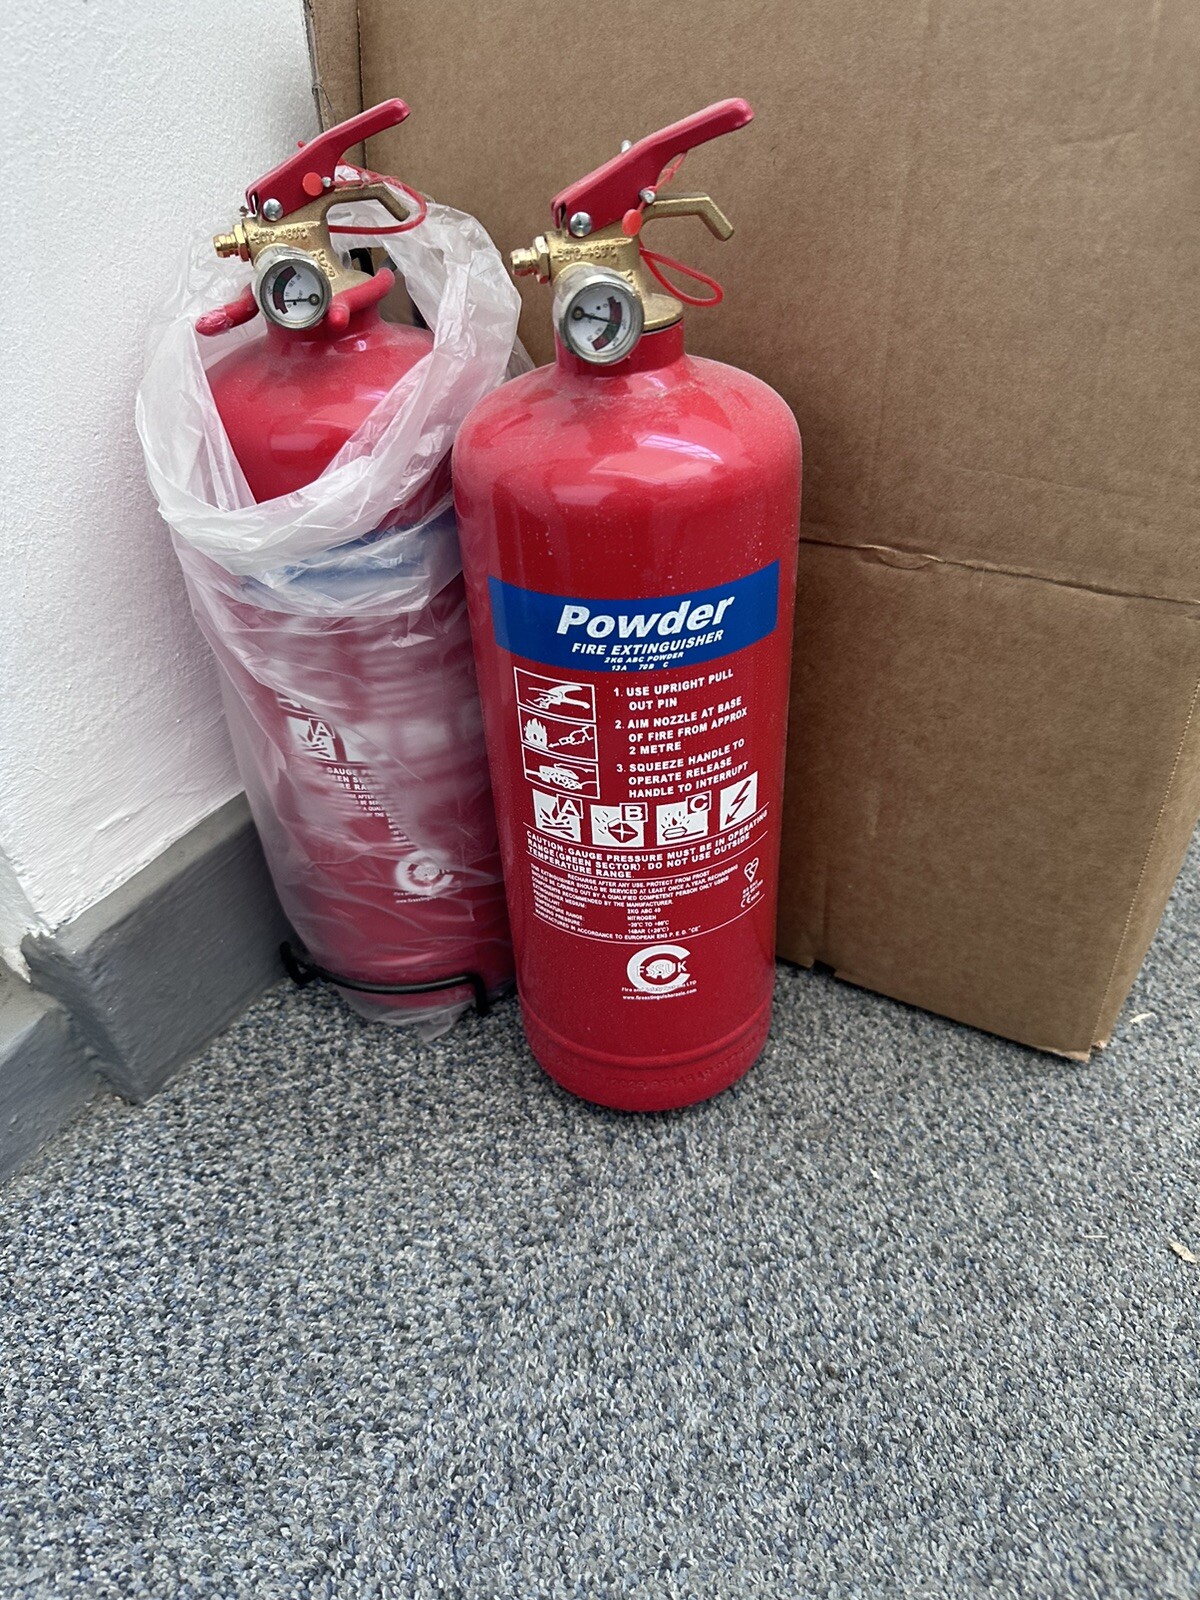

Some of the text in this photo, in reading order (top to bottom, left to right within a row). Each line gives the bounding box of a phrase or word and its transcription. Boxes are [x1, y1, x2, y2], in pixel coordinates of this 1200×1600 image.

[556, 596, 735, 638] Powder
[572, 629, 724, 656] FIRE EXTINGUISHER
[646, 651, 684, 662] POWDER
[614, 668, 734, 697] 1. USE UPRIGHT PULL
[615, 696, 742, 730] 2. AIM NOZZLE AT BASE
[628, 698, 678, 711] OUT PIN
[315, 722, 330, 736] A
[628, 706, 748, 742] OF FIRE FROM APPROX
[616, 738, 745, 773] 3. SQUEEZE HANDLE TO
[629, 742, 682, 755] 2 METRE
[628, 756, 732, 786] OPERATE RELEASE
[628, 762, 749, 798] HANDLE TO INTERRUPT
[559, 794, 708, 820] A B C
[568, 848, 603, 860] GAUGE
[606, 853, 663, 864] PRESSURE
[666, 847, 696, 860] MUST
[700, 842, 712, 853] BE
[715, 837, 725, 847] IN
[728, 810, 768, 841] OPERATING
[666, 858, 688, 868] NOT
[692, 851, 711, 863] USE
[714, 832, 750, 856] OUTSIDE
[528, 846, 634, 878] TEMPERATURE RANGE.
[531, 869, 548, 881] SHOULD
[557, 880, 579, 893] CARRIED
[675, 887, 698, 897] PERSON
[699, 882, 712, 891] ONLY
[531, 876, 561, 895] COMPONENTS
[562, 891, 602, 905] RECOMMENDED
[532, 882, 564, 901] EXTINGUISHER
[540, 868, 575, 886] EXTINGUISHER
[576, 883, 598, 891] SHOULD
[707, 864, 738, 882] RECHARGING
[567, 873, 597, 885] RECHARGE
[675, 876, 691, 884] FROM
[692, 870, 710, 880] FROST
[534, 895, 564, 915] TEMPERATURE
[535, 908, 569, 929] MANUFACTURED
[577, 927, 613, 939] ACCORDANCE
